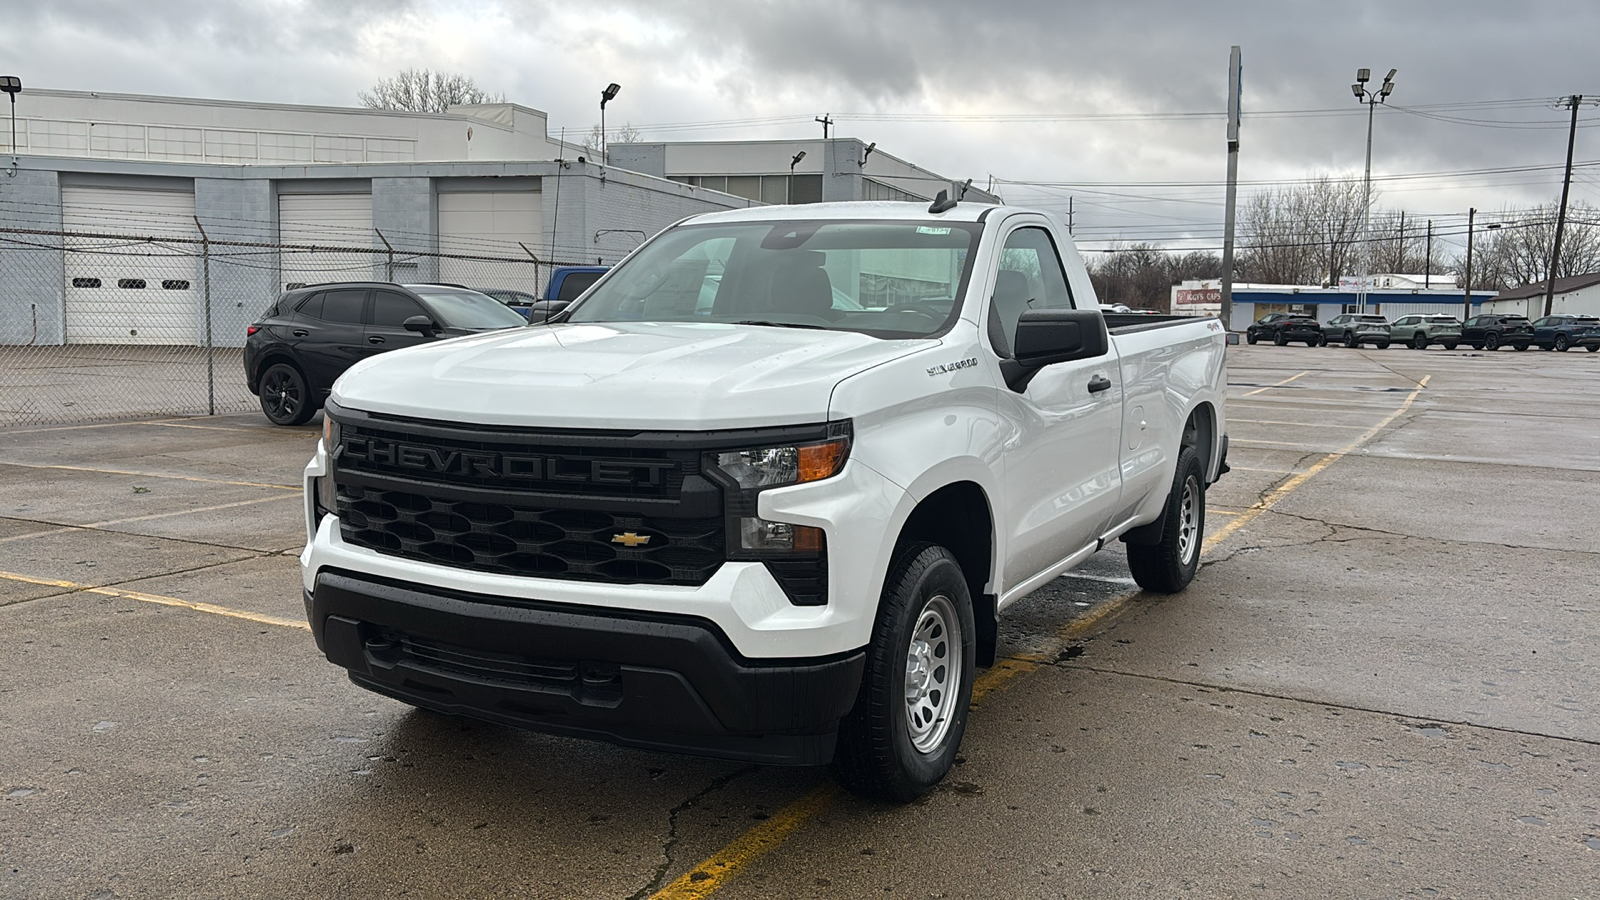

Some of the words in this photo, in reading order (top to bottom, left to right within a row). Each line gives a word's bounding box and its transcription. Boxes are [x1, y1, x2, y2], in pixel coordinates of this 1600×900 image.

[1206, 292, 1221, 300] CAPS
[926, 357, 979, 377] SILVERADO
[342, 438, 676, 487] CHEVROLET
